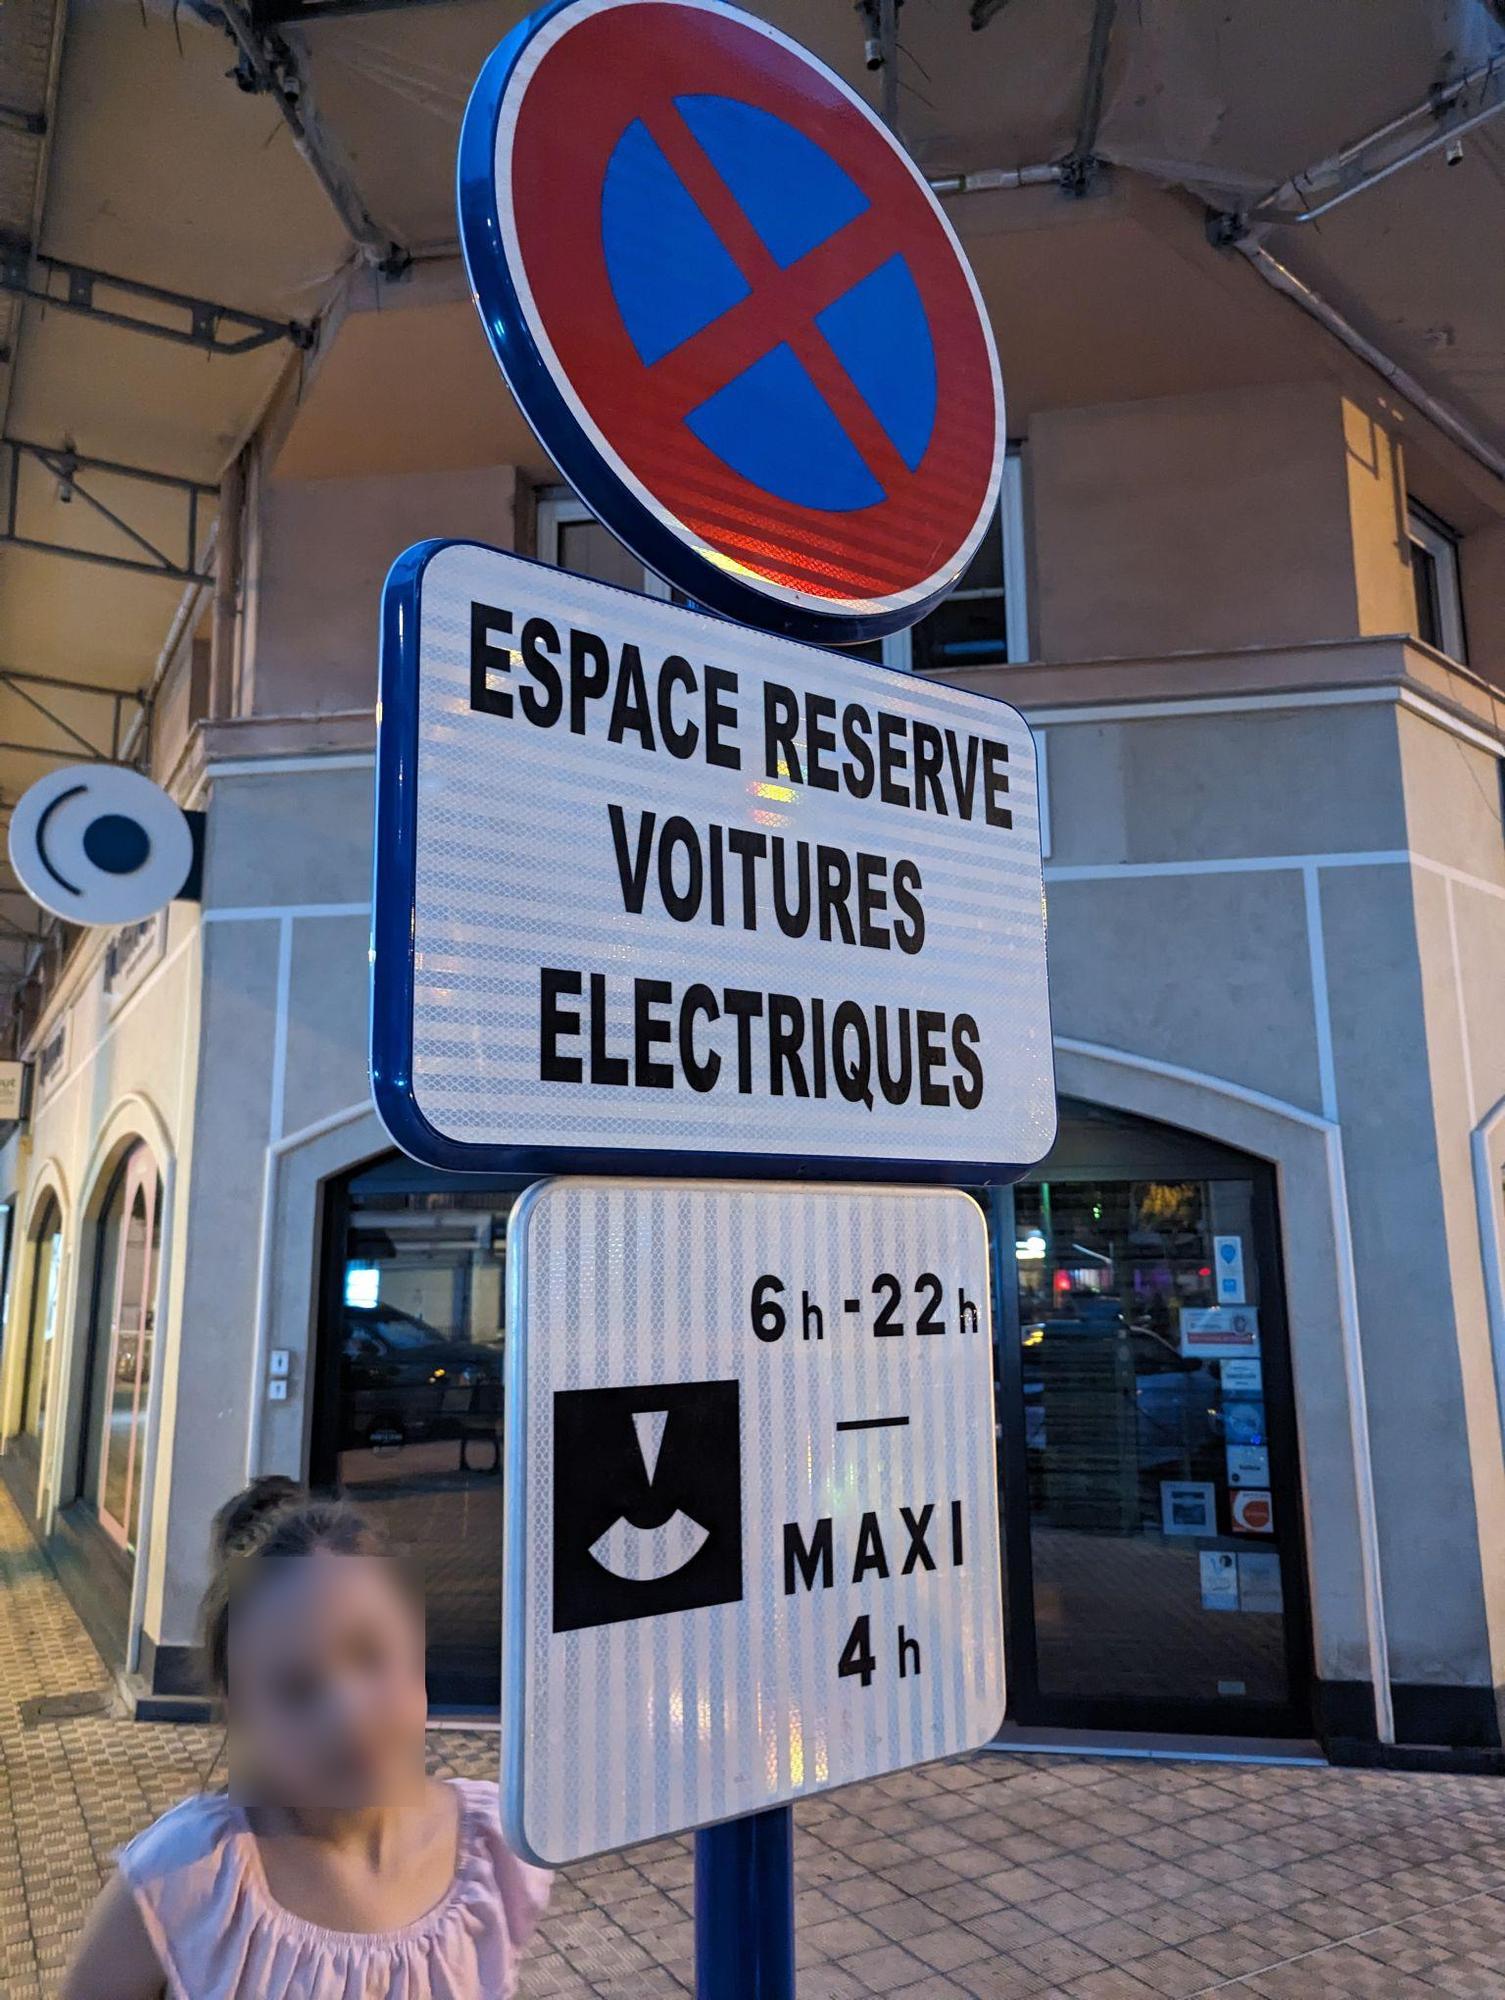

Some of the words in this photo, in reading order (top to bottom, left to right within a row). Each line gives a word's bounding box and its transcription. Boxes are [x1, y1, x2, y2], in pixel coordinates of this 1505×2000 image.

[470, 601, 742, 770] ESPACE
[764, 681, 1013, 829] RESERVE
[608, 804, 925, 954] VOITURES
[541, 968, 984, 1112] ELECTRIQUES
[784, 1501, 963, 1596] MAXI
